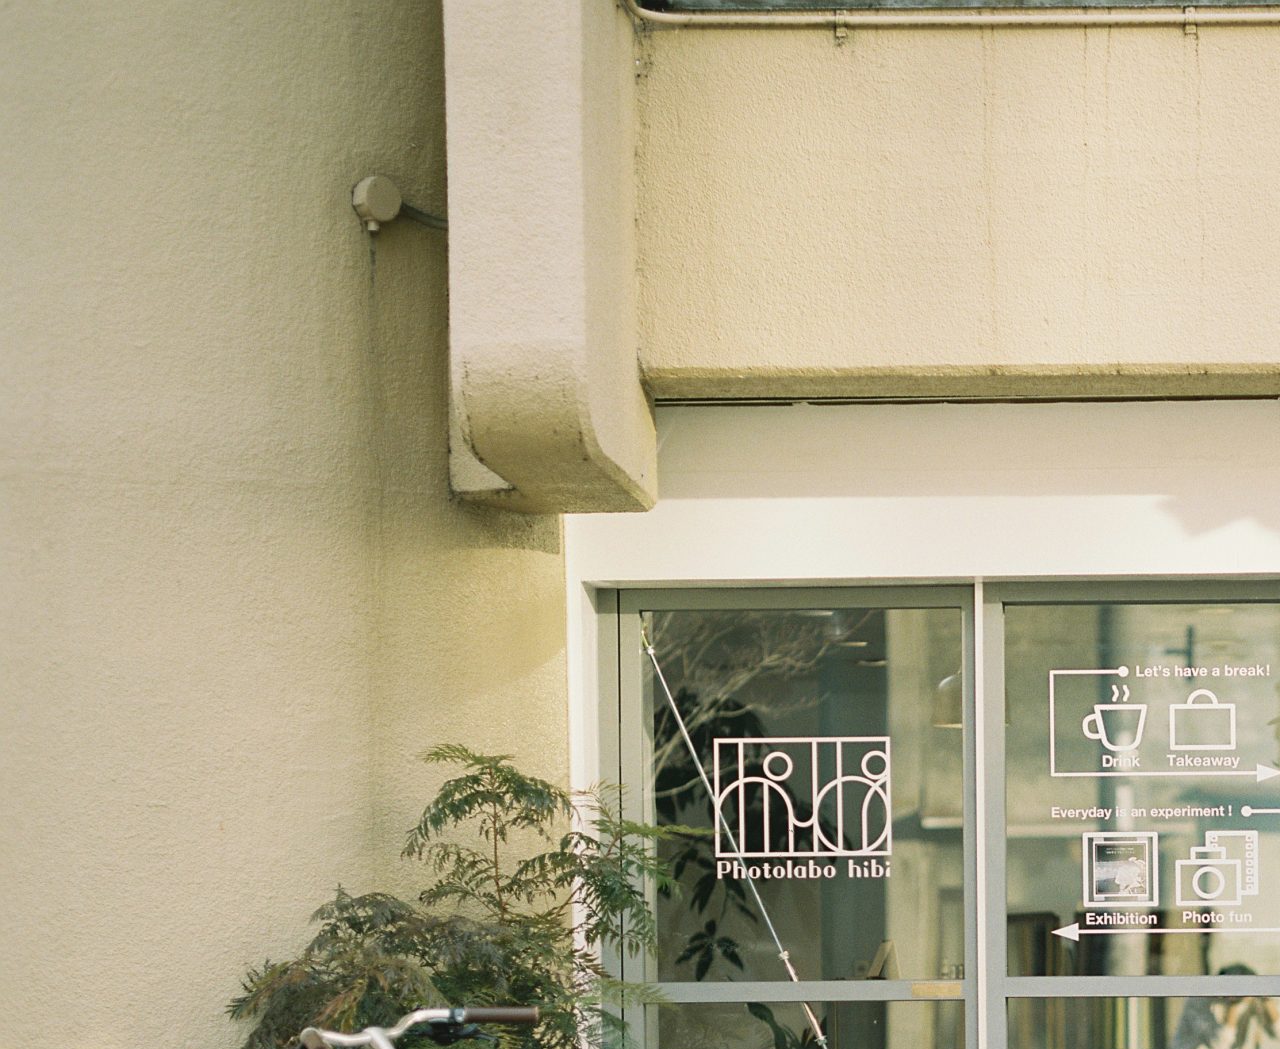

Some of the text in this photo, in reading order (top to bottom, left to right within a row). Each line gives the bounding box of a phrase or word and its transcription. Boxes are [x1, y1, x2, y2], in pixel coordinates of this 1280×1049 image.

[1135, 664, 1271, 678] Let's have a break!
[1102, 754, 1140, 768] Drink
[1166, 754, 1240, 769] Takeaway
[1051, 806, 1112, 820] Everyday
[1131, 808, 1147, 818] an
[716, 859, 891, 879] Photolabo hibi
[1085, 911, 1158, 925] Exhibition
[1182, 911, 1253, 924] Photo fun
